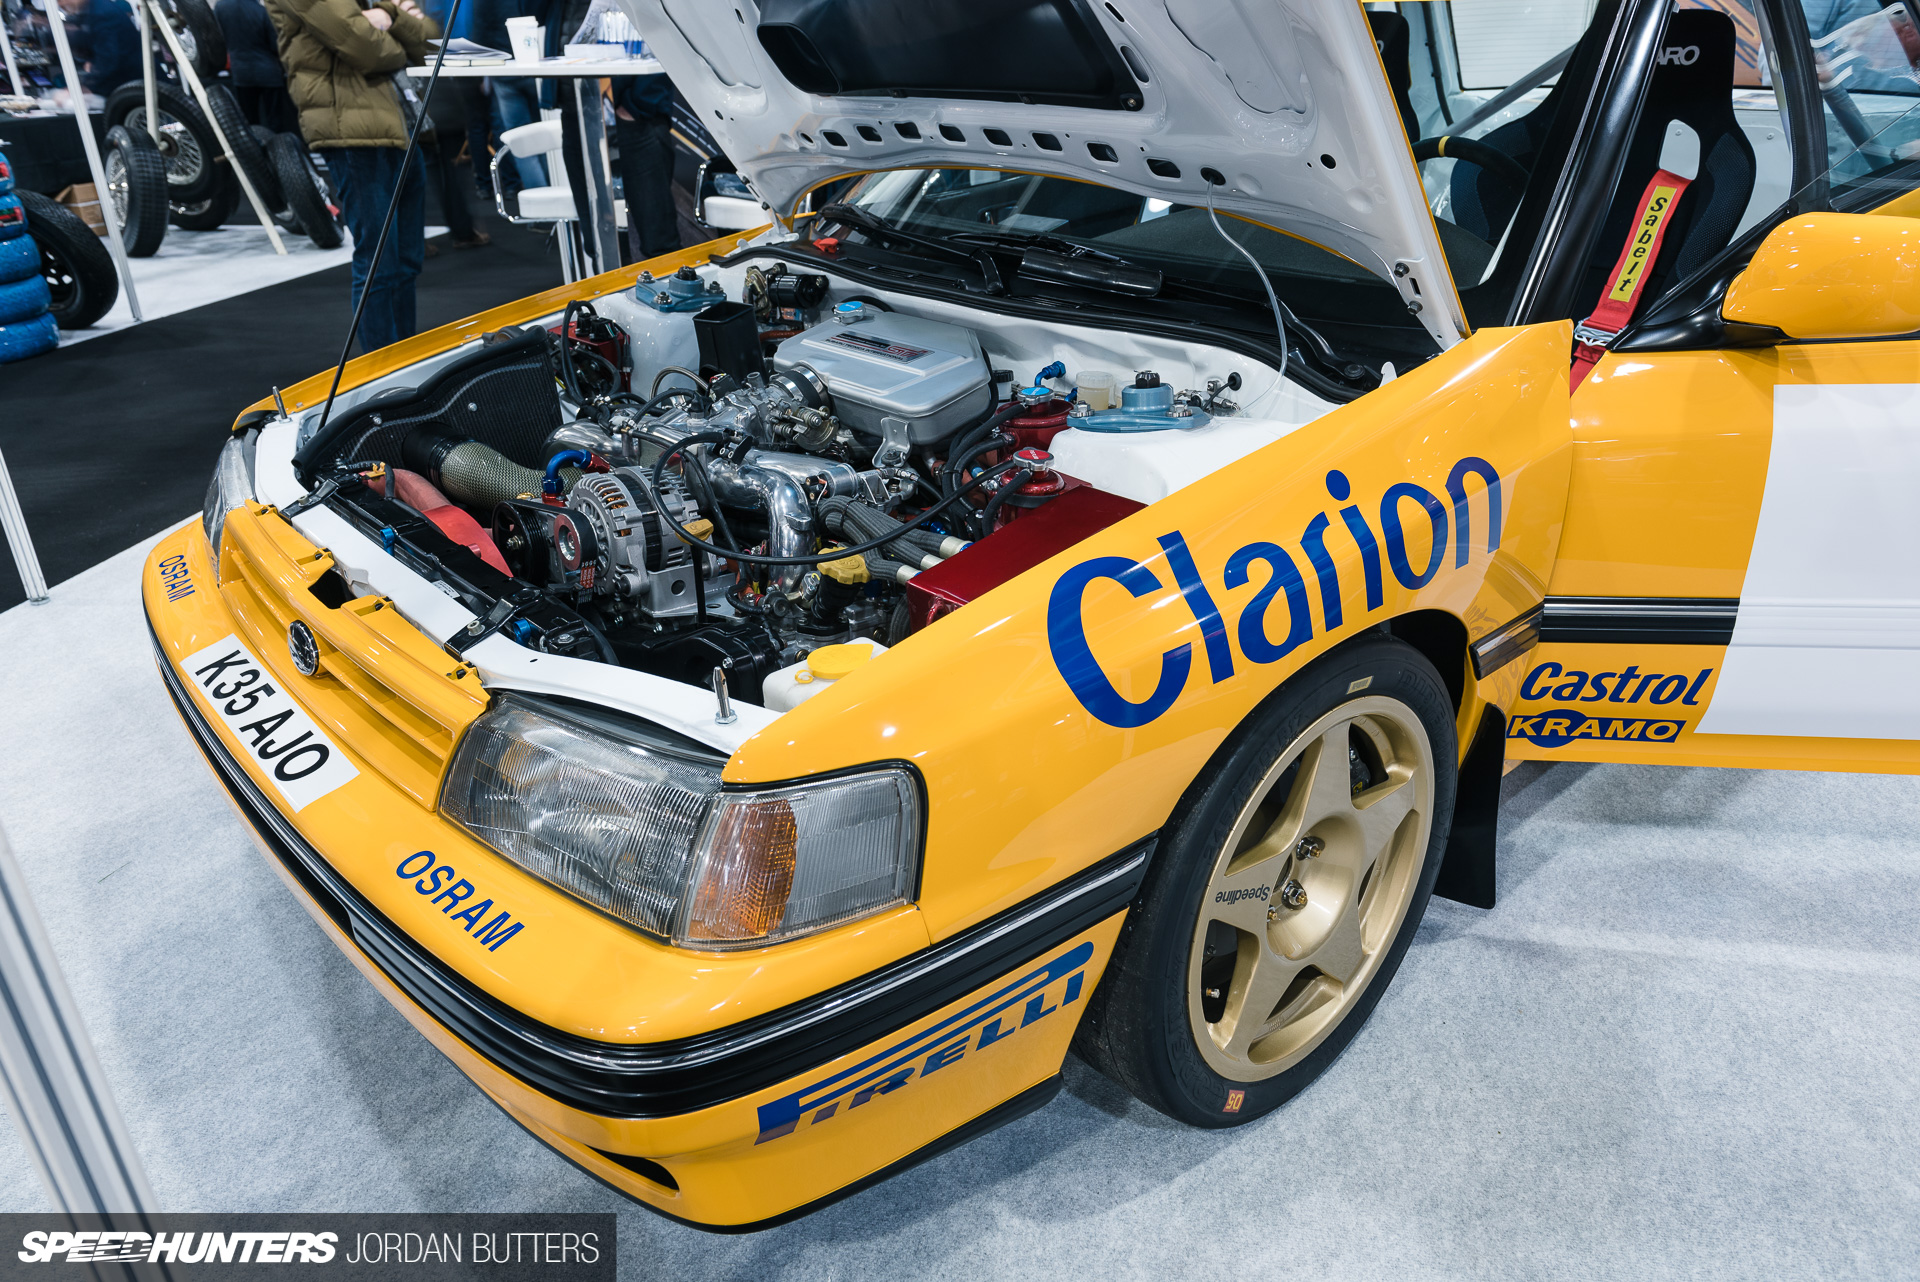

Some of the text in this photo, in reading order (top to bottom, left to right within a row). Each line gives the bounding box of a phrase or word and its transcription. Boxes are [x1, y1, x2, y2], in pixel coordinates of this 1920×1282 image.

[1657, 45, 1700, 65] ARO
[1618, 196, 1668, 292] Sabelt
[158, 554, 195, 603] OSRAM
[1047, 456, 1502, 729] Clarion
[195, 649, 330, 782] K35 AJO
[1519, 661, 1714, 706] Castrol
[1508, 717, 1679, 741] KRAMO
[396, 850, 526, 952] OSRAM
[1215, 883, 1270, 905] Speedline
[753, 940, 1095, 1146] PIRELLI
